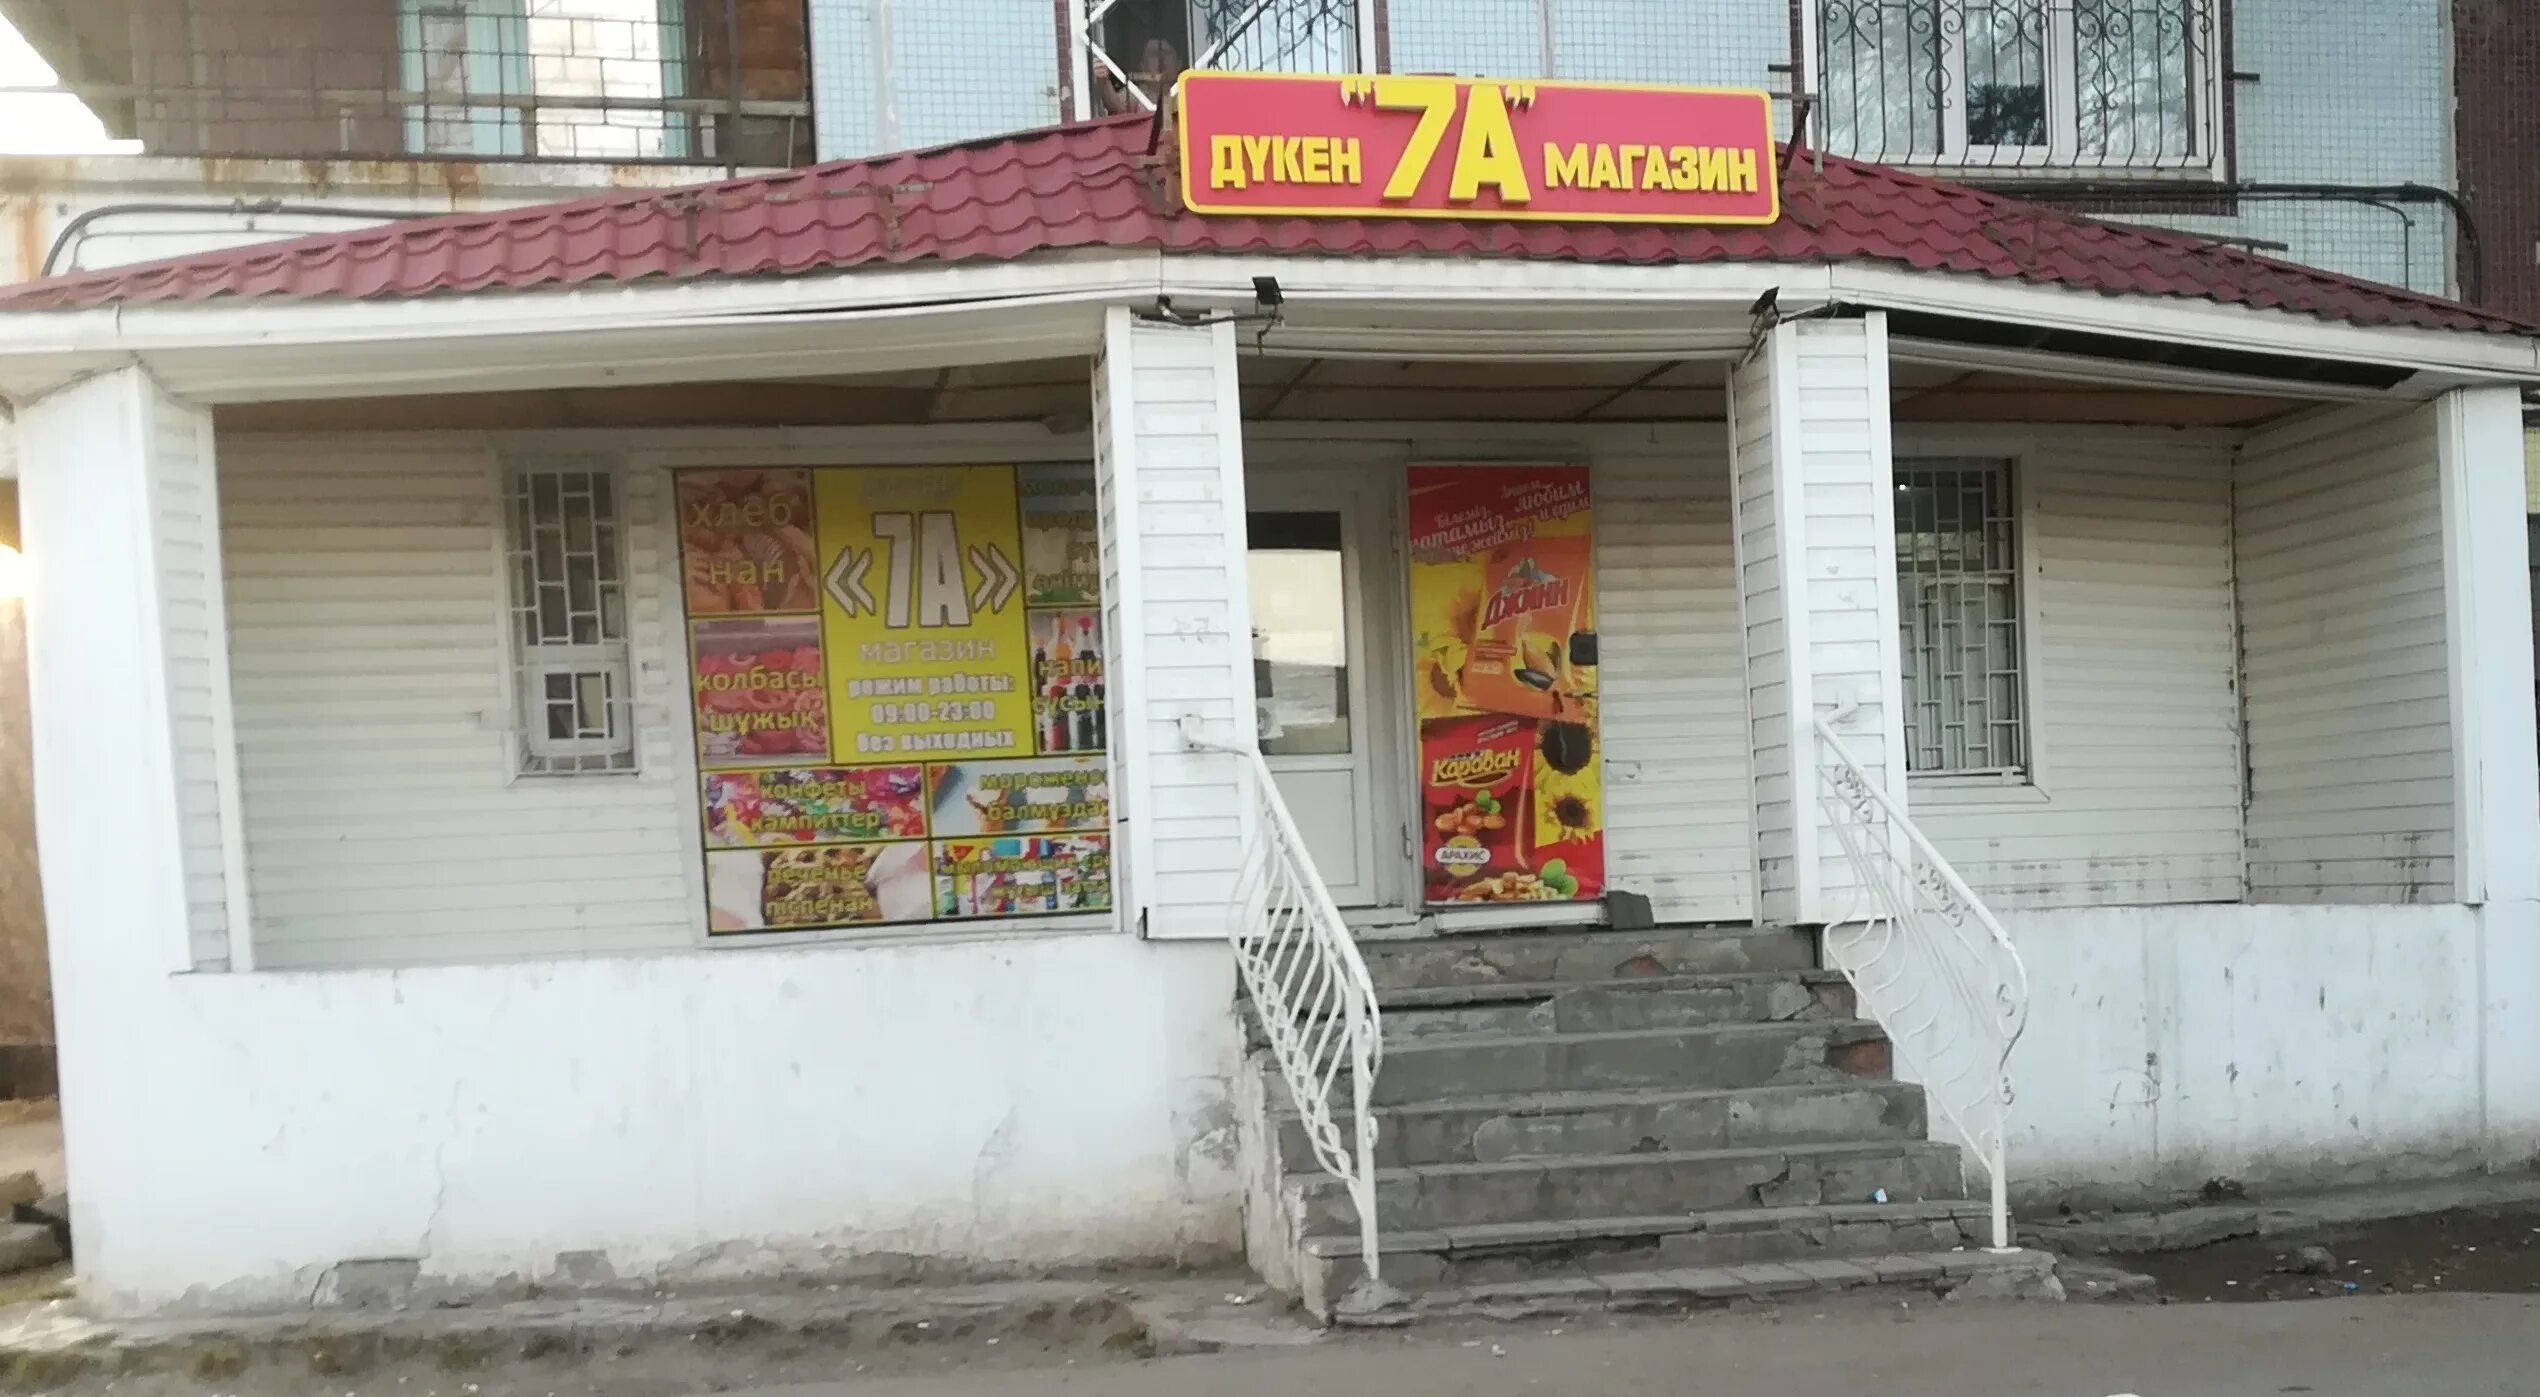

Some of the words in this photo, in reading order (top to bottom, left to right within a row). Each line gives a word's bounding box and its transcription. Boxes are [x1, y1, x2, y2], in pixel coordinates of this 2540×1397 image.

[1211, 134, 1362, 189] ДҮКЕН
[1543, 142, 1758, 193] МАГАЗИН
[690, 493, 792, 528] хлеб
[708, 560, 785, 585] нан
[859, 638, 997, 665] магазин
[694, 664, 823, 691] колбасы
[848, 676, 922, 699] режим
[927, 672, 1016, 697] работы:
[871, 700, 995, 724] 09:00-23:00
[856, 731, 896, 753] без
[900, 729, 1015, 752] выходных
[760, 779, 866, 799] конфеты
[978, 768, 1107, 791] морожено
[1440, 849, 1486, 862] АРАХИС
[766, 865, 867, 883] печенье
